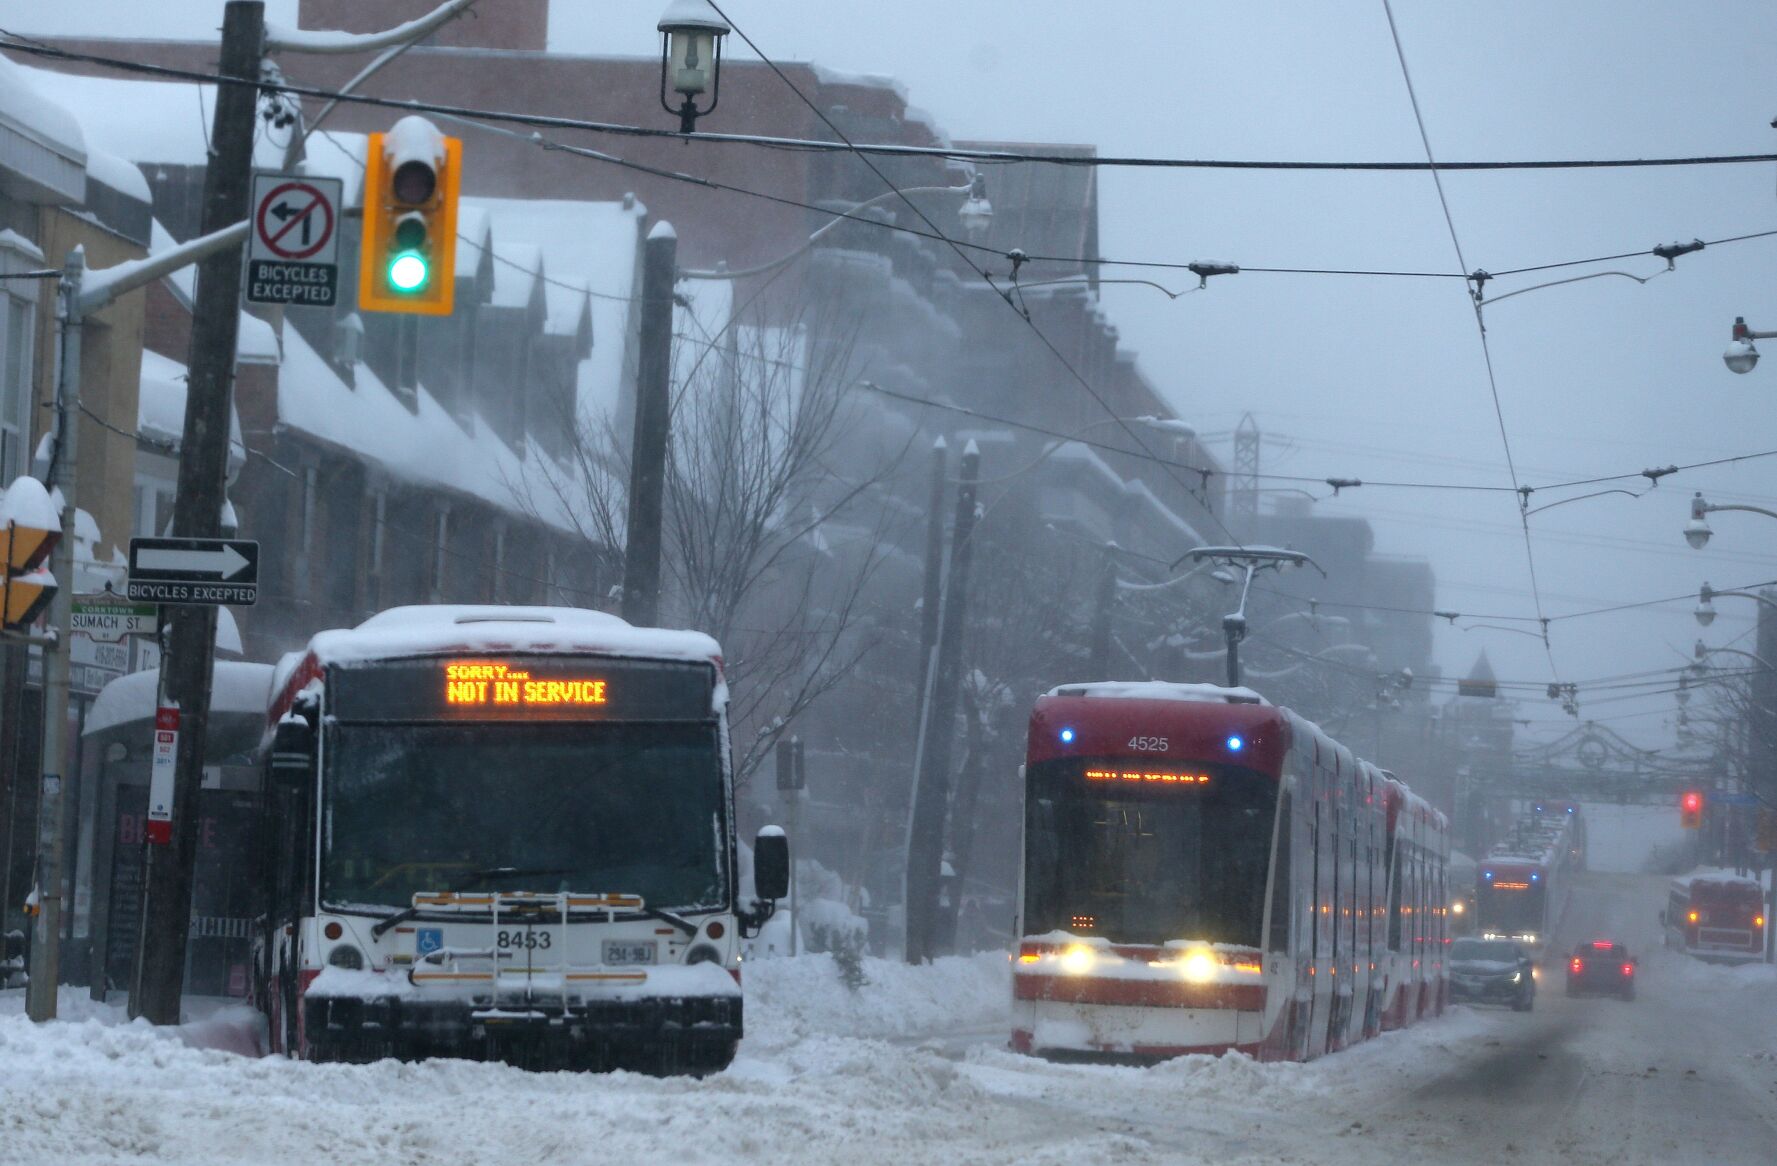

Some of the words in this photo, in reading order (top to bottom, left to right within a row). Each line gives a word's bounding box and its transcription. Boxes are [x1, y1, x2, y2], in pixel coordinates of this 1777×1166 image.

[258, 265, 328, 282] BICYCLES
[253, 283, 331, 300] EXCEPTED
[129, 584, 188, 599] BICYCLES
[194, 587, 255, 601] EXCEPTED
[81, 605, 134, 615] CORKTOWN
[72, 615, 118, 630] SUMACH
[447, 681, 488, 702] NOT
[494, 681, 518, 702] IN
[524, 681, 606, 702] SERVICE
[1128, 736, 1169, 752] 4525
[497, 931, 551, 949] 8453
